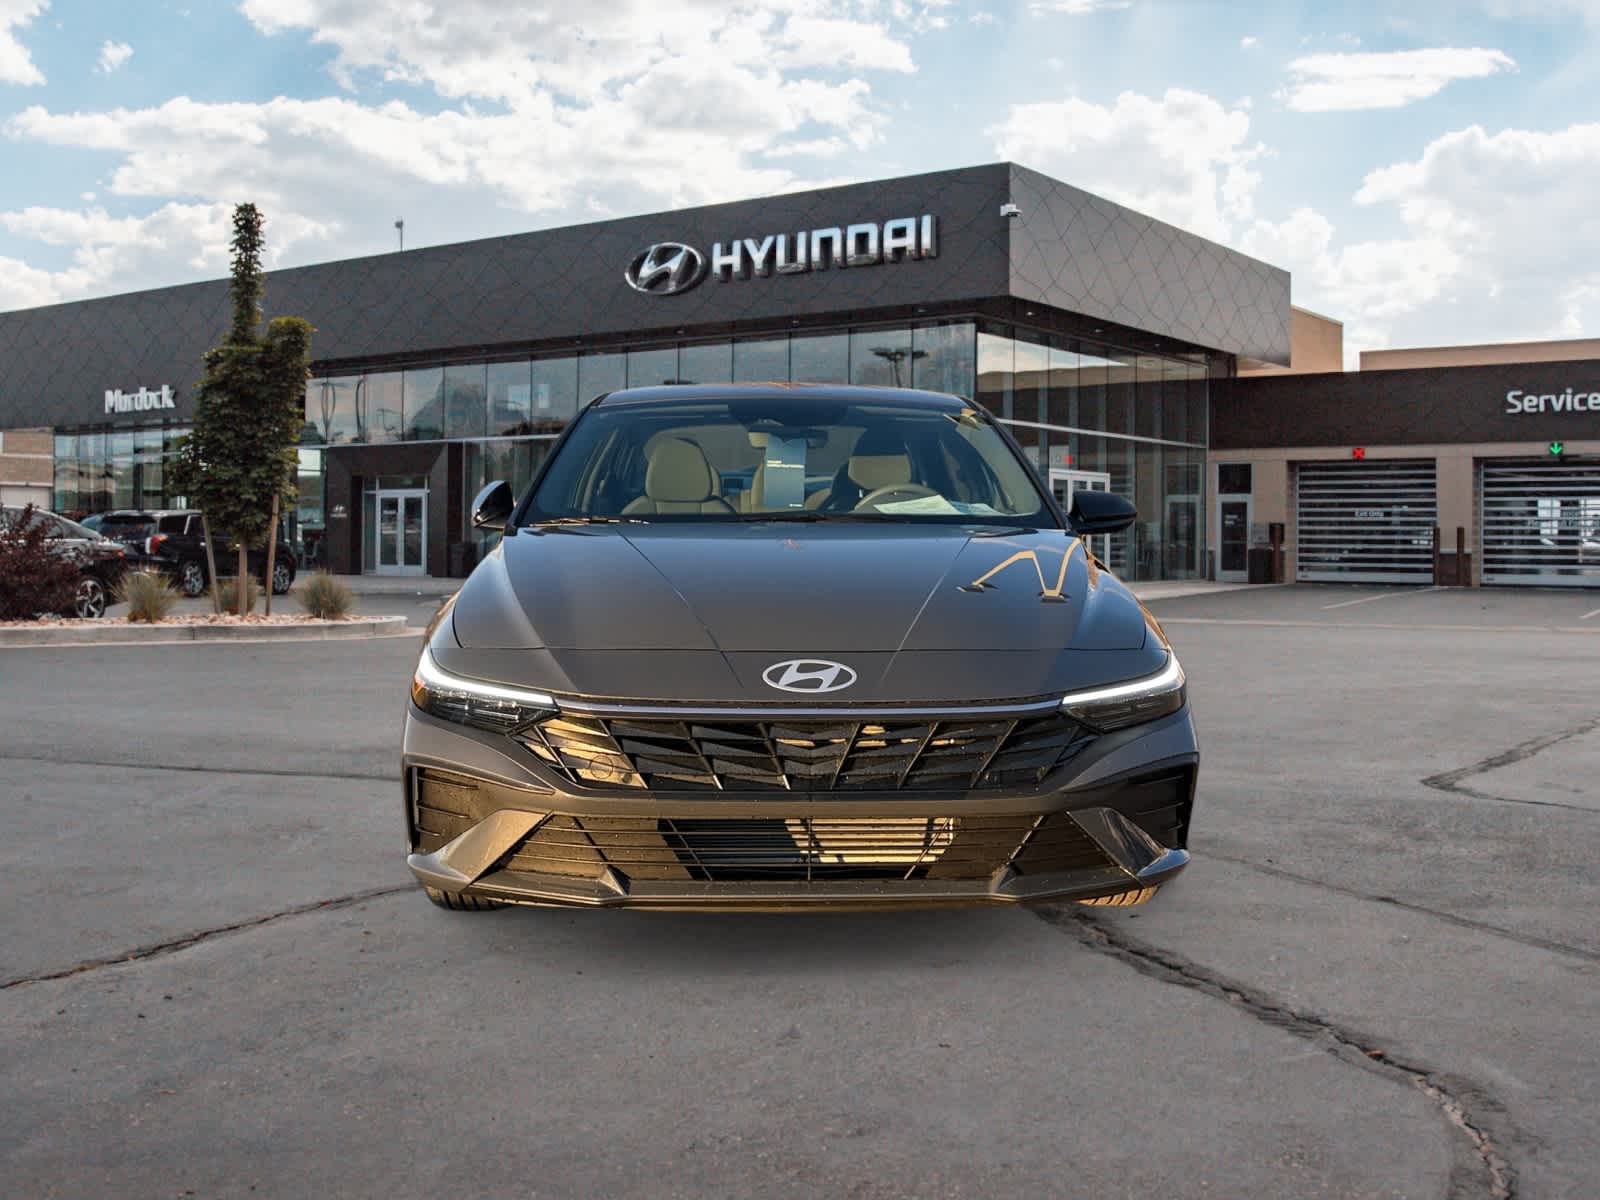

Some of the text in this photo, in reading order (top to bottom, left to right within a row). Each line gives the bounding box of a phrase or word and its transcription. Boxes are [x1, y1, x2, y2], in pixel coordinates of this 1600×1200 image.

[711, 213, 936, 281] HYUNDAI
[104, 384, 176, 414] Murdock
[1505, 387, 1600, 414] Service
